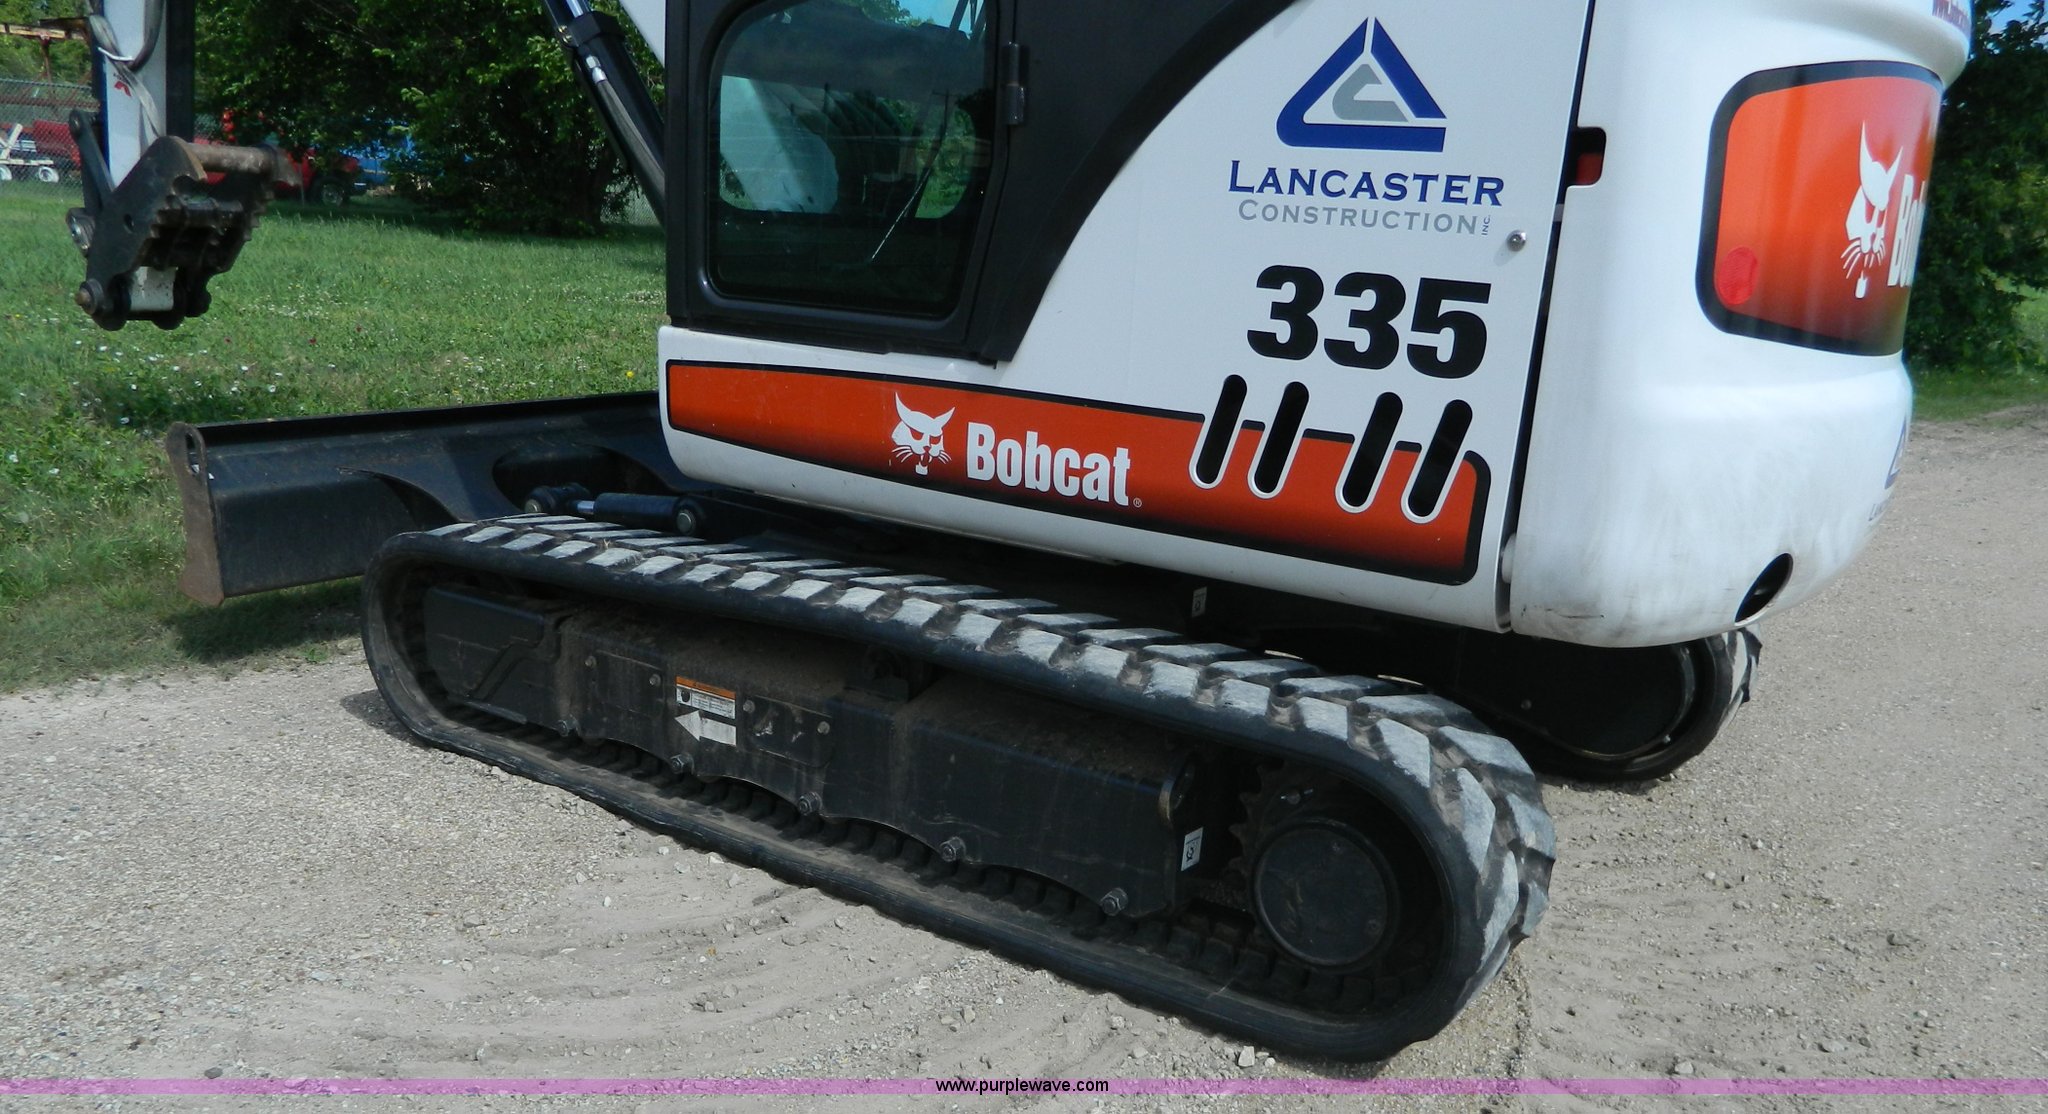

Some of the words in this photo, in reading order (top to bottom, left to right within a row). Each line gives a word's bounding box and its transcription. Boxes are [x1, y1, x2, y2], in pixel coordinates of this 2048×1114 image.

[1228, 160, 1505, 206] LANCASTER
[1238, 199, 1478, 235] CONSTRUCTION
[1247, 265, 1491, 379] 335
[966, 421, 1131, 506] Bobcat
